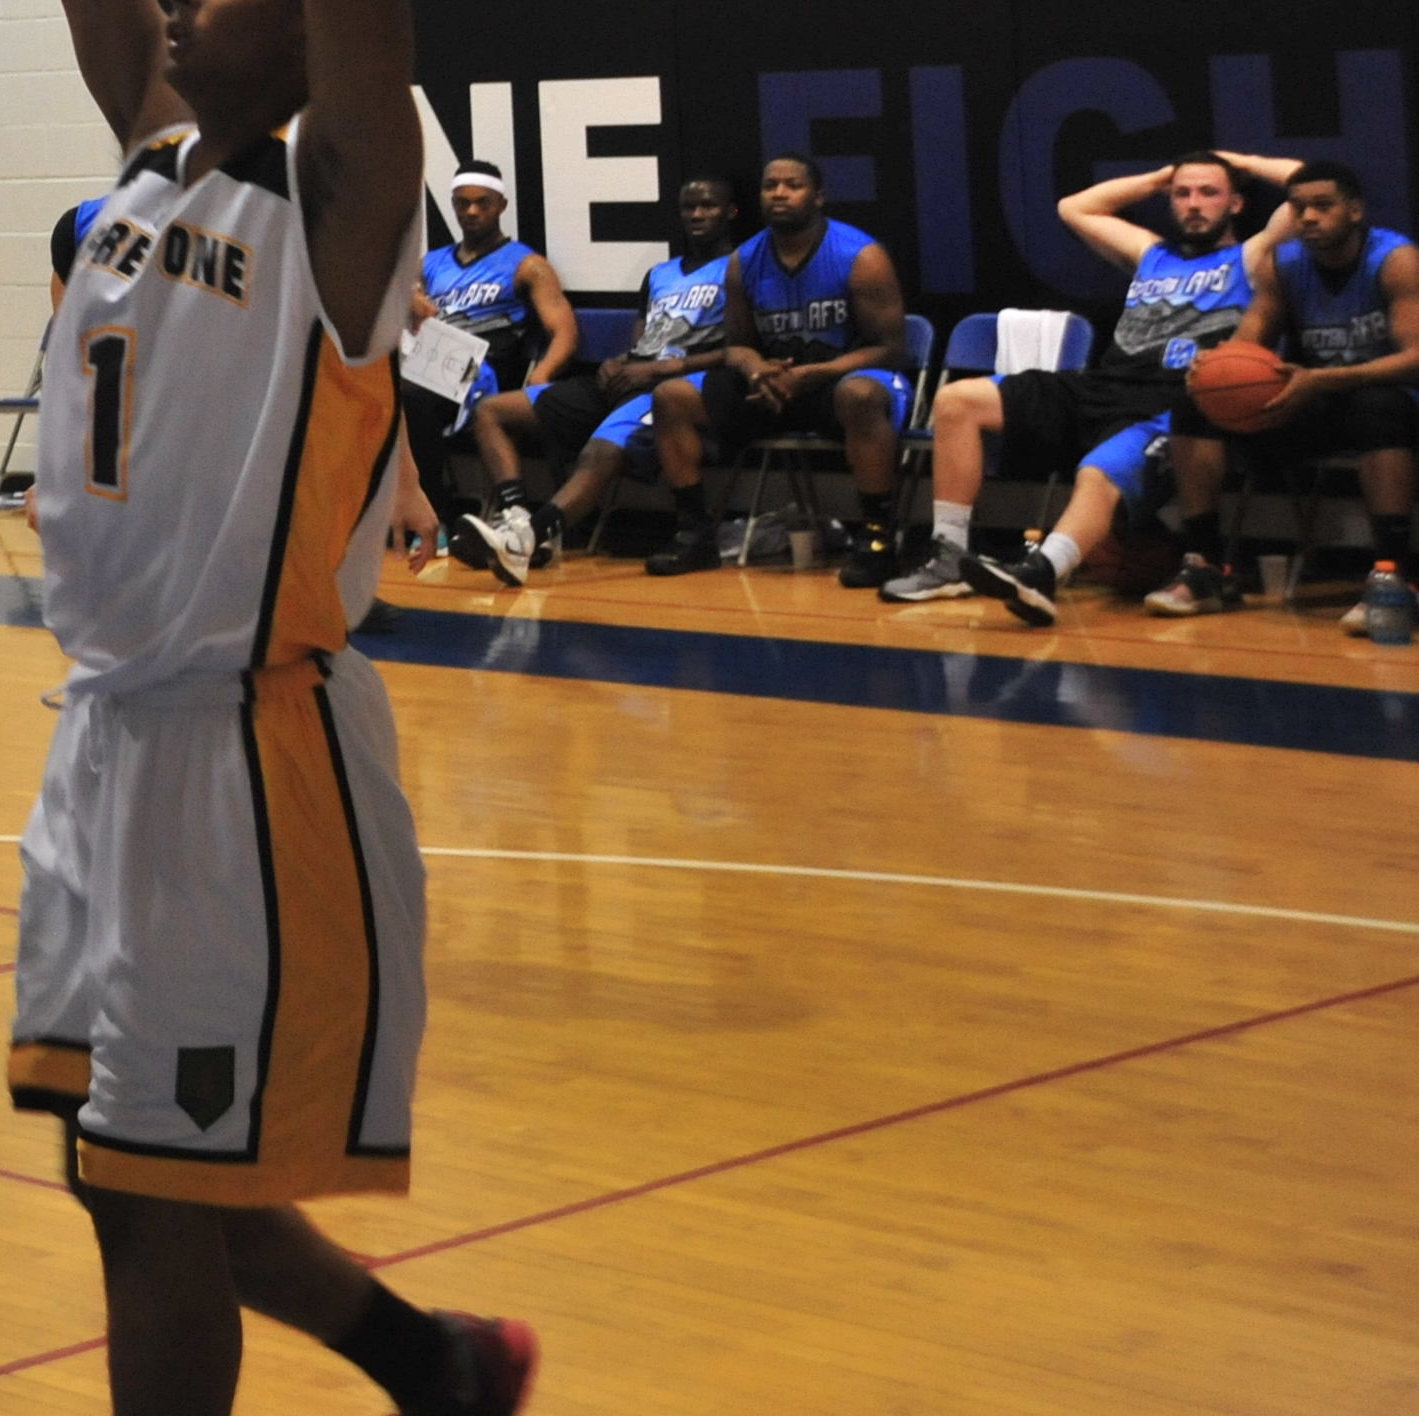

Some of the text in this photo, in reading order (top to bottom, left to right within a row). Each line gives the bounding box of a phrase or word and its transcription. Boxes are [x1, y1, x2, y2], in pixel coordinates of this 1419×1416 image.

[89, 222, 249, 303] RE ONE
[410, 76, 671, 293] NE
[83, 329, 132, 495] 1
